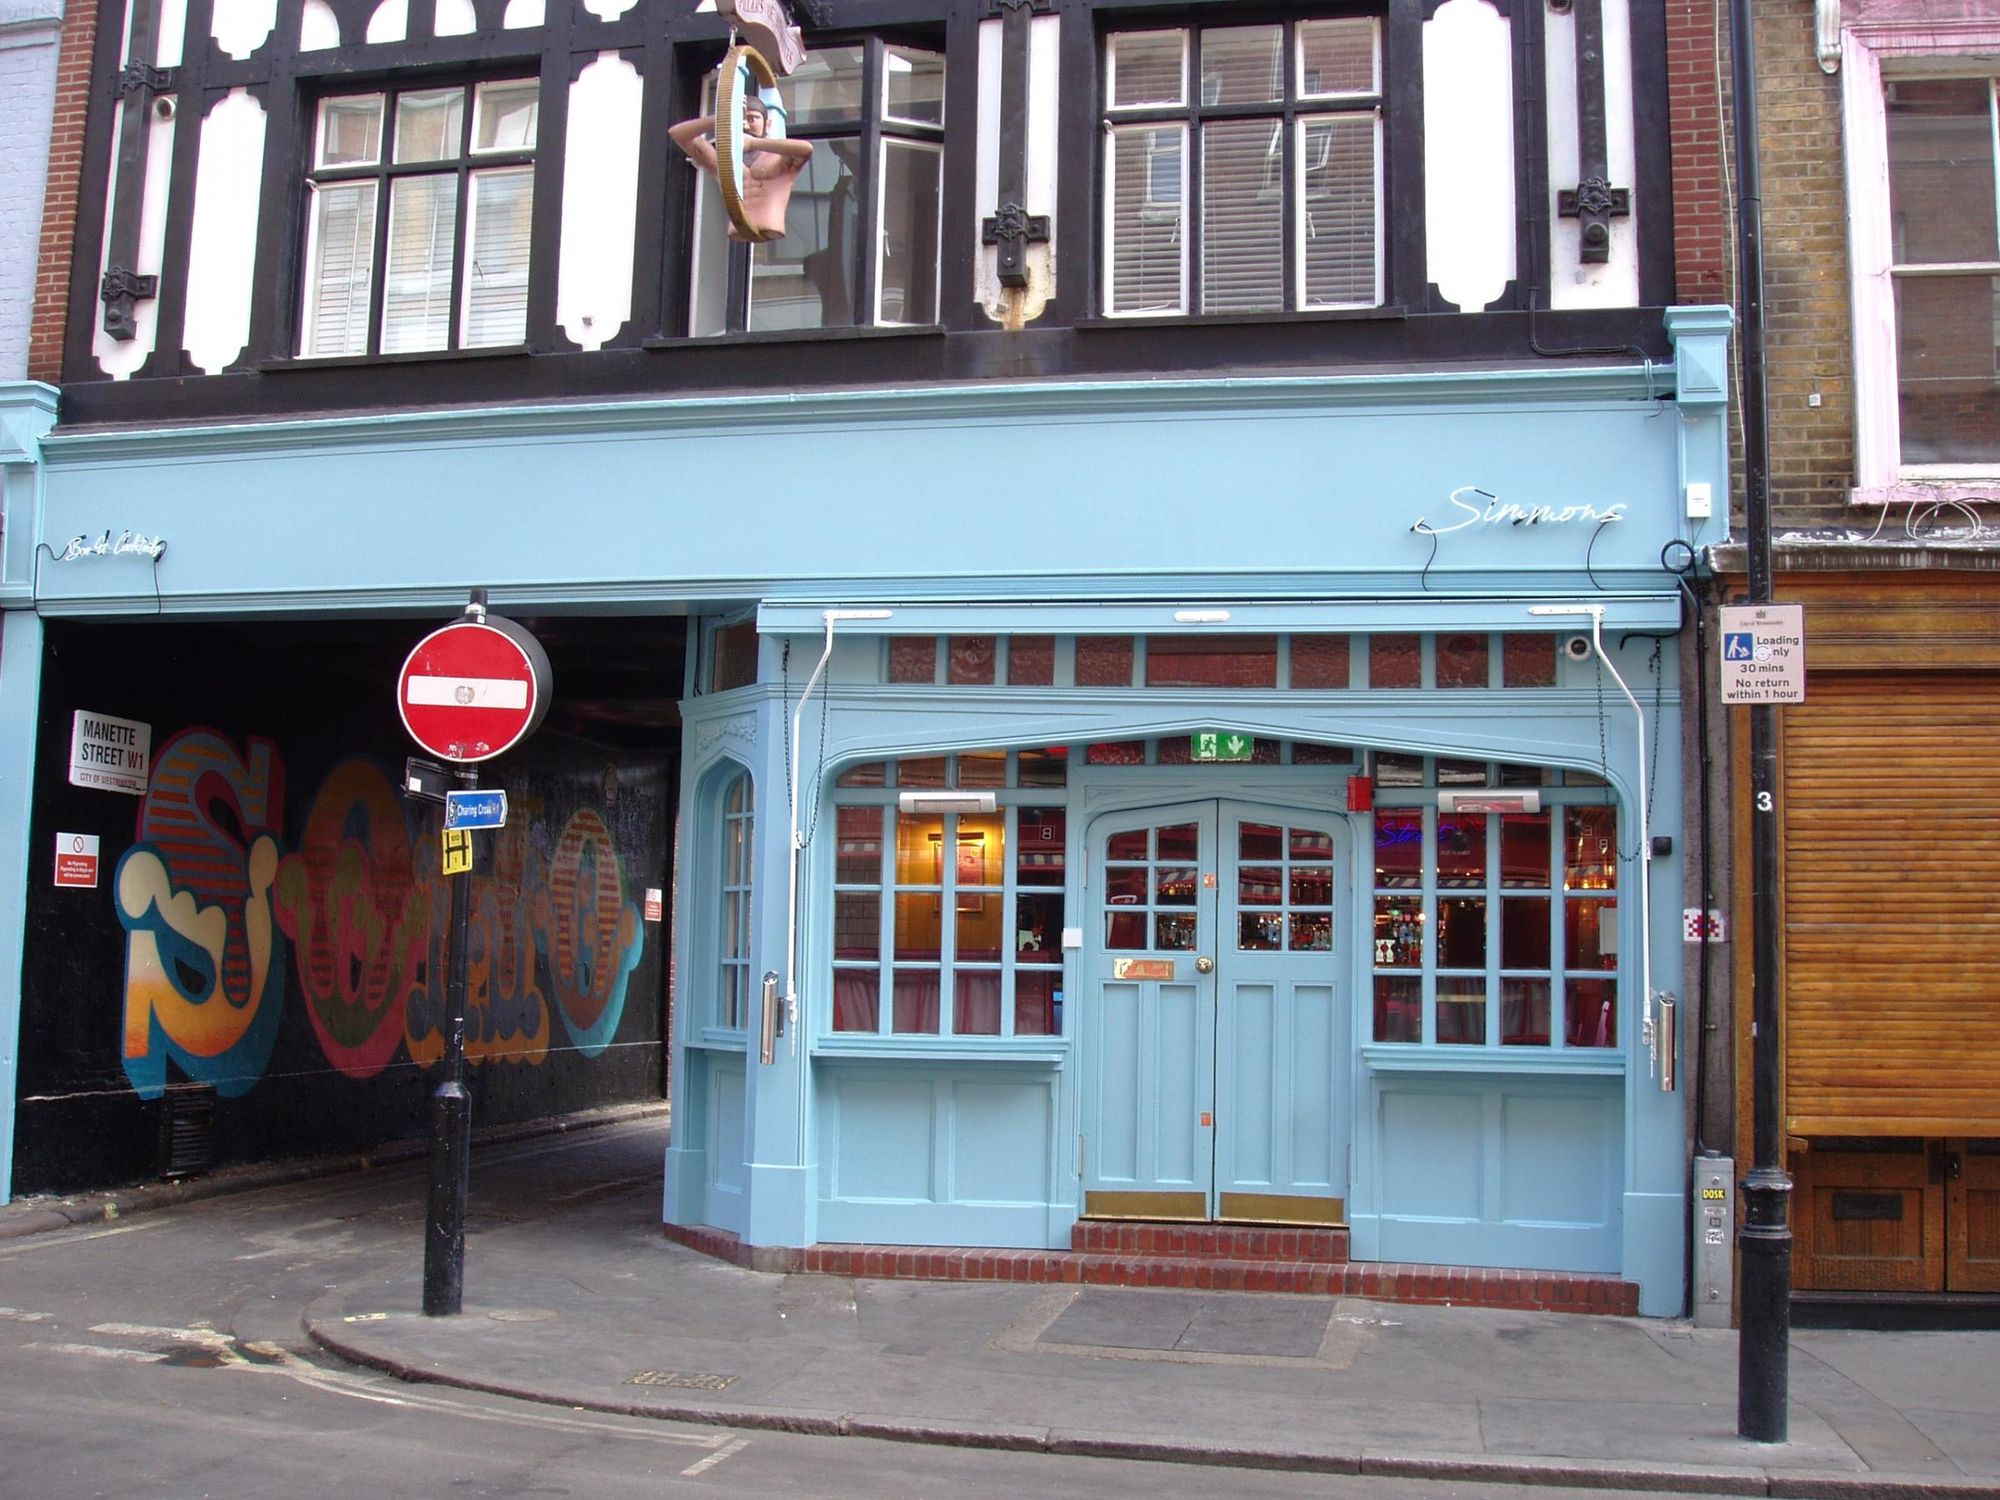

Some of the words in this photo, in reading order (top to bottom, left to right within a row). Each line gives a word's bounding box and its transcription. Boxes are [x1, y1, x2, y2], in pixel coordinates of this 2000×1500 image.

[1413, 486, 1629, 534] Simmons
[1756, 636, 1799, 646] Loading
[1766, 646, 1790, 657] nly
[1740, 664, 1756, 673] 30
[1758, 663, 1785, 673] mins
[1735, 679, 1751, 688] No
[1755, 679, 1790, 687] return
[1727, 690, 1761, 699] within
[1764, 690, 1769, 698] 1
[1773, 690, 1799, 698] hour
[83, 719, 136, 746] MANETTE
[82, 742, 124, 767] STREET
[127, 750, 144, 770] W1
[1756, 791, 1772, 812] 3
[456, 804, 478, 817] Charing
[478, 803, 492, 815] Cross
[1703, 1189, 1725, 1199] DOSK
